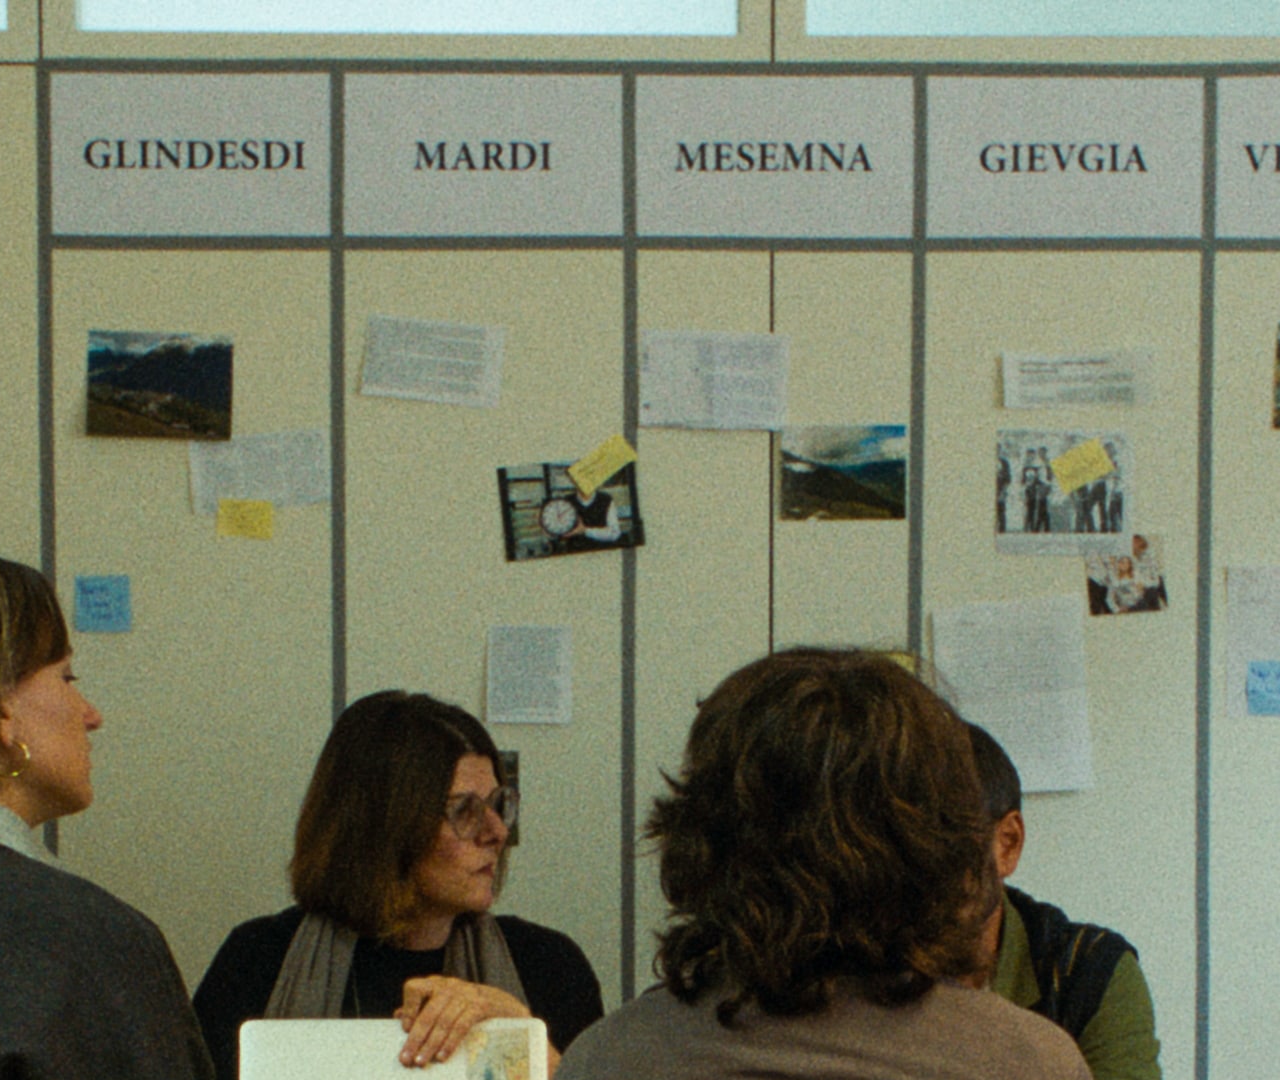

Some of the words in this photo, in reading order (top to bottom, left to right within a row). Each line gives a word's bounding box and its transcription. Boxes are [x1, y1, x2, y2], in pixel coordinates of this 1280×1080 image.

[82, 138, 306, 171] GLINDESDI
[414, 140, 552, 172] MARDI
[674, 141, 875, 173] MESEMNA
[978, 142, 1148, 174] GIEVGIA
